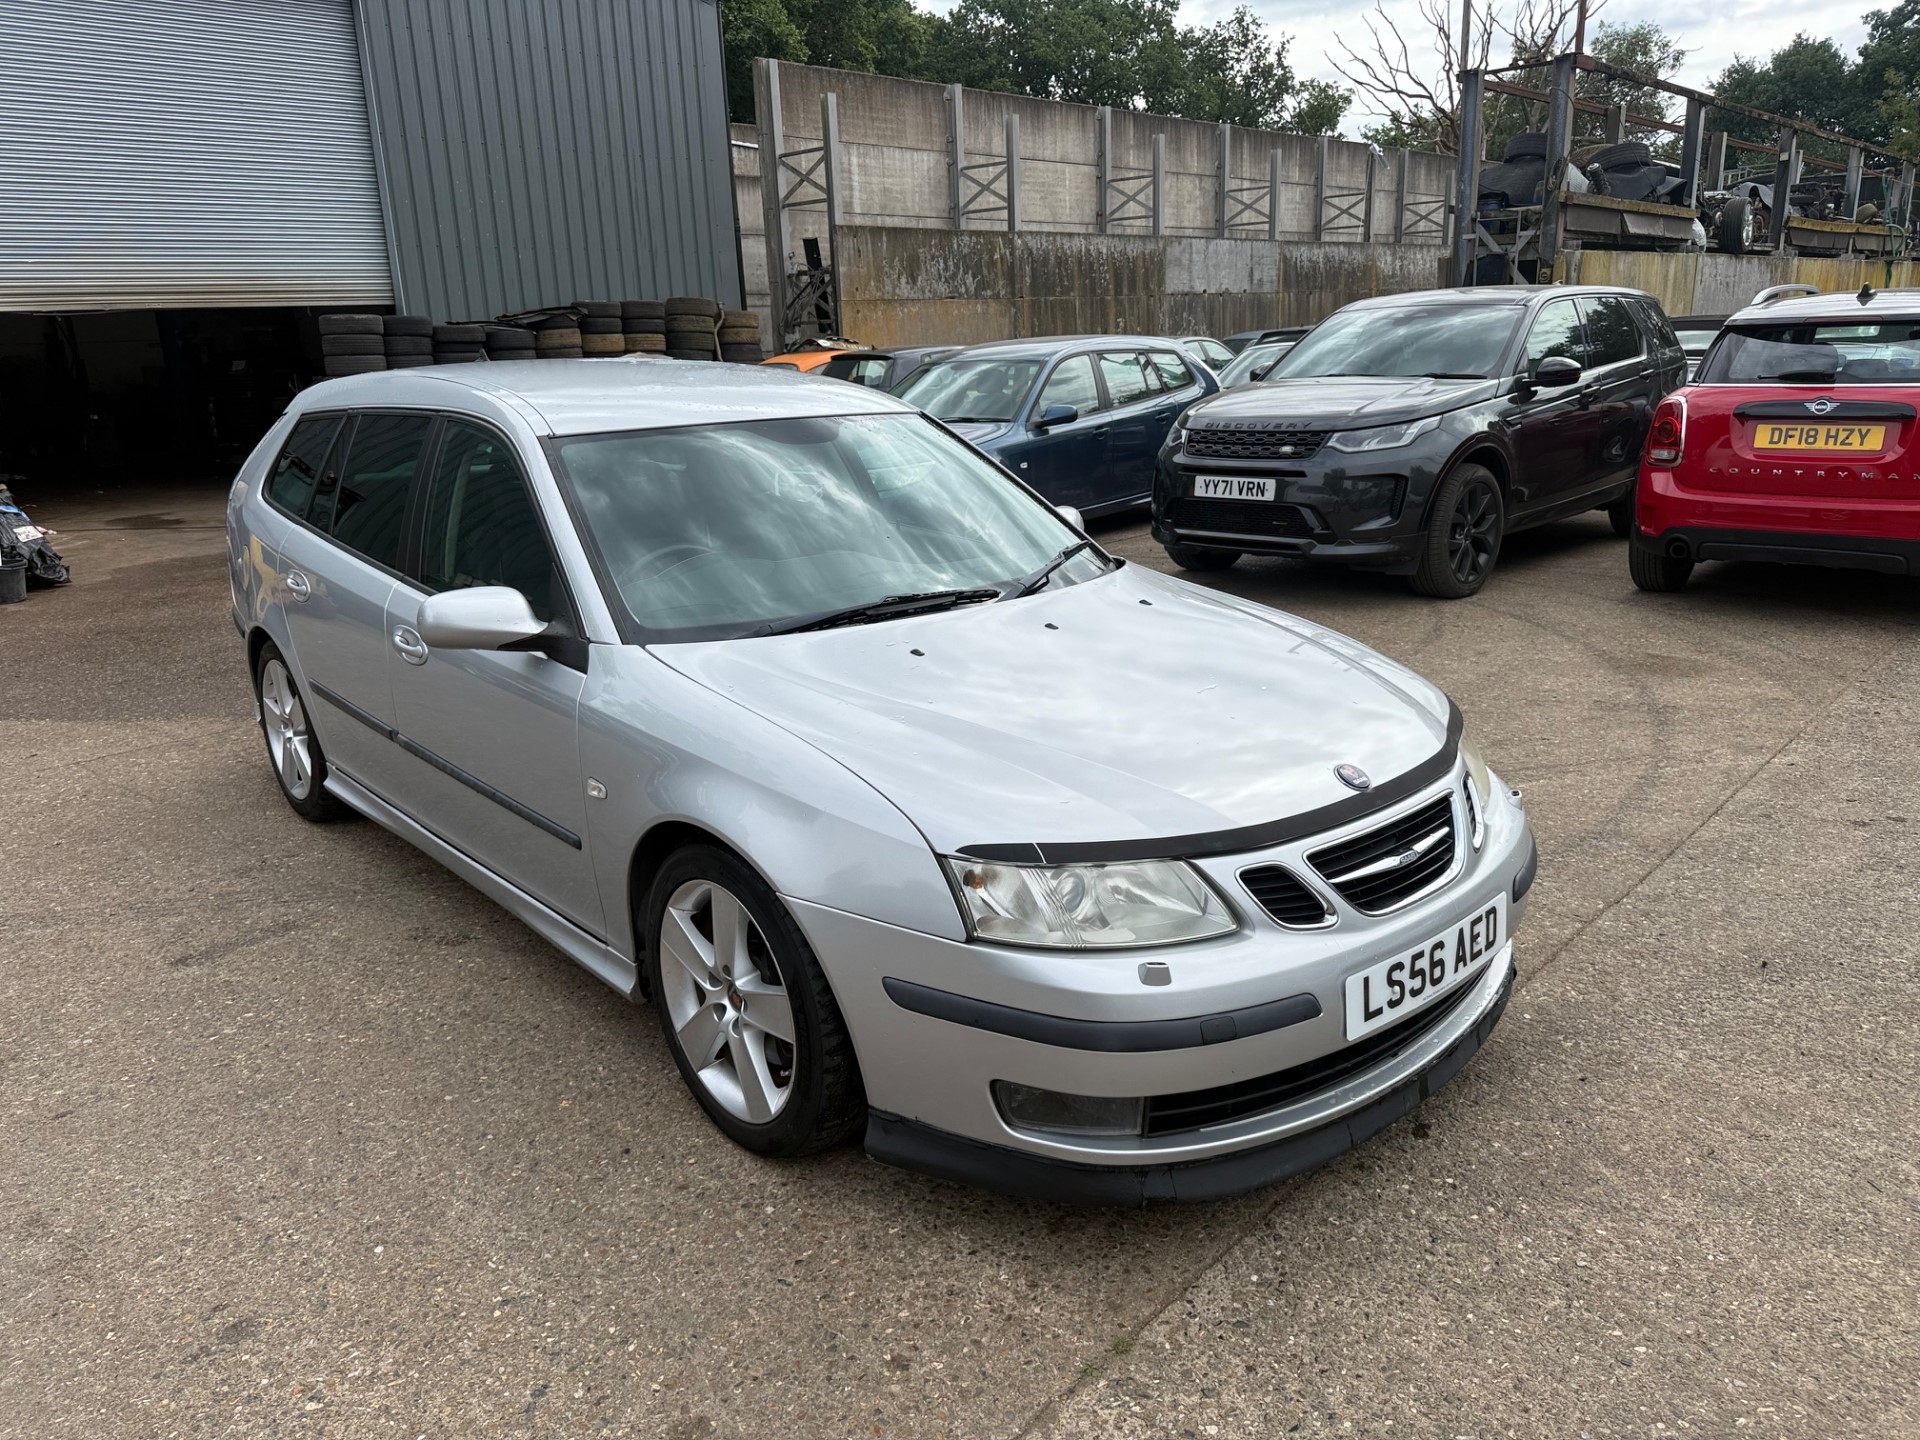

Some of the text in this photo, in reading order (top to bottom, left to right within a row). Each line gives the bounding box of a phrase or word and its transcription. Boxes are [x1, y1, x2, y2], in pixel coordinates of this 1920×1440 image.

[1205, 421, 1313, 430] DISCOVERY
[1768, 427, 1871, 446] DF18 HZY
[1203, 478, 1266, 498] YY71 VRN
[1363, 905, 1497, 1023] LS56 AED
